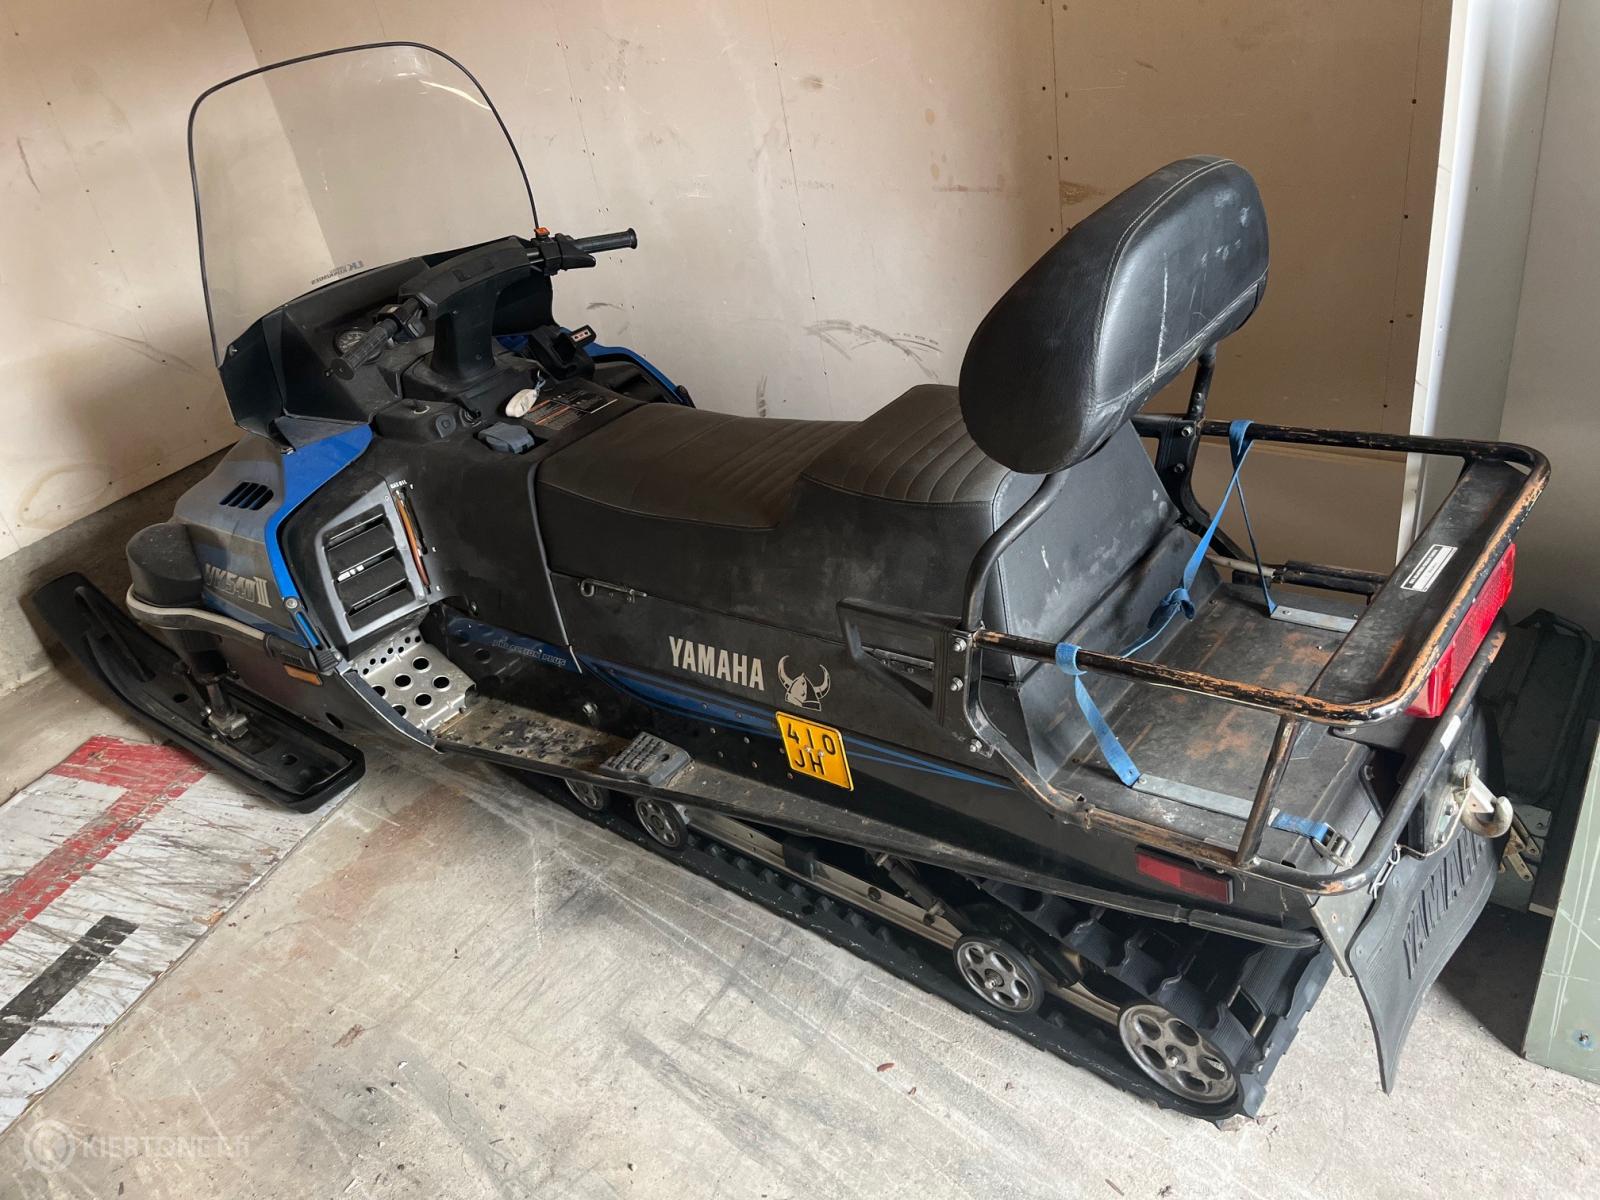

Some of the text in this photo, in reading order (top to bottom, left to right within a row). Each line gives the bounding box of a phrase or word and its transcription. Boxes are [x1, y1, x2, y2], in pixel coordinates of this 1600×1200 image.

[668, 635, 765, 691] YAMAHA
[787, 722, 837, 756] 410
[793, 749, 825, 776] JH
